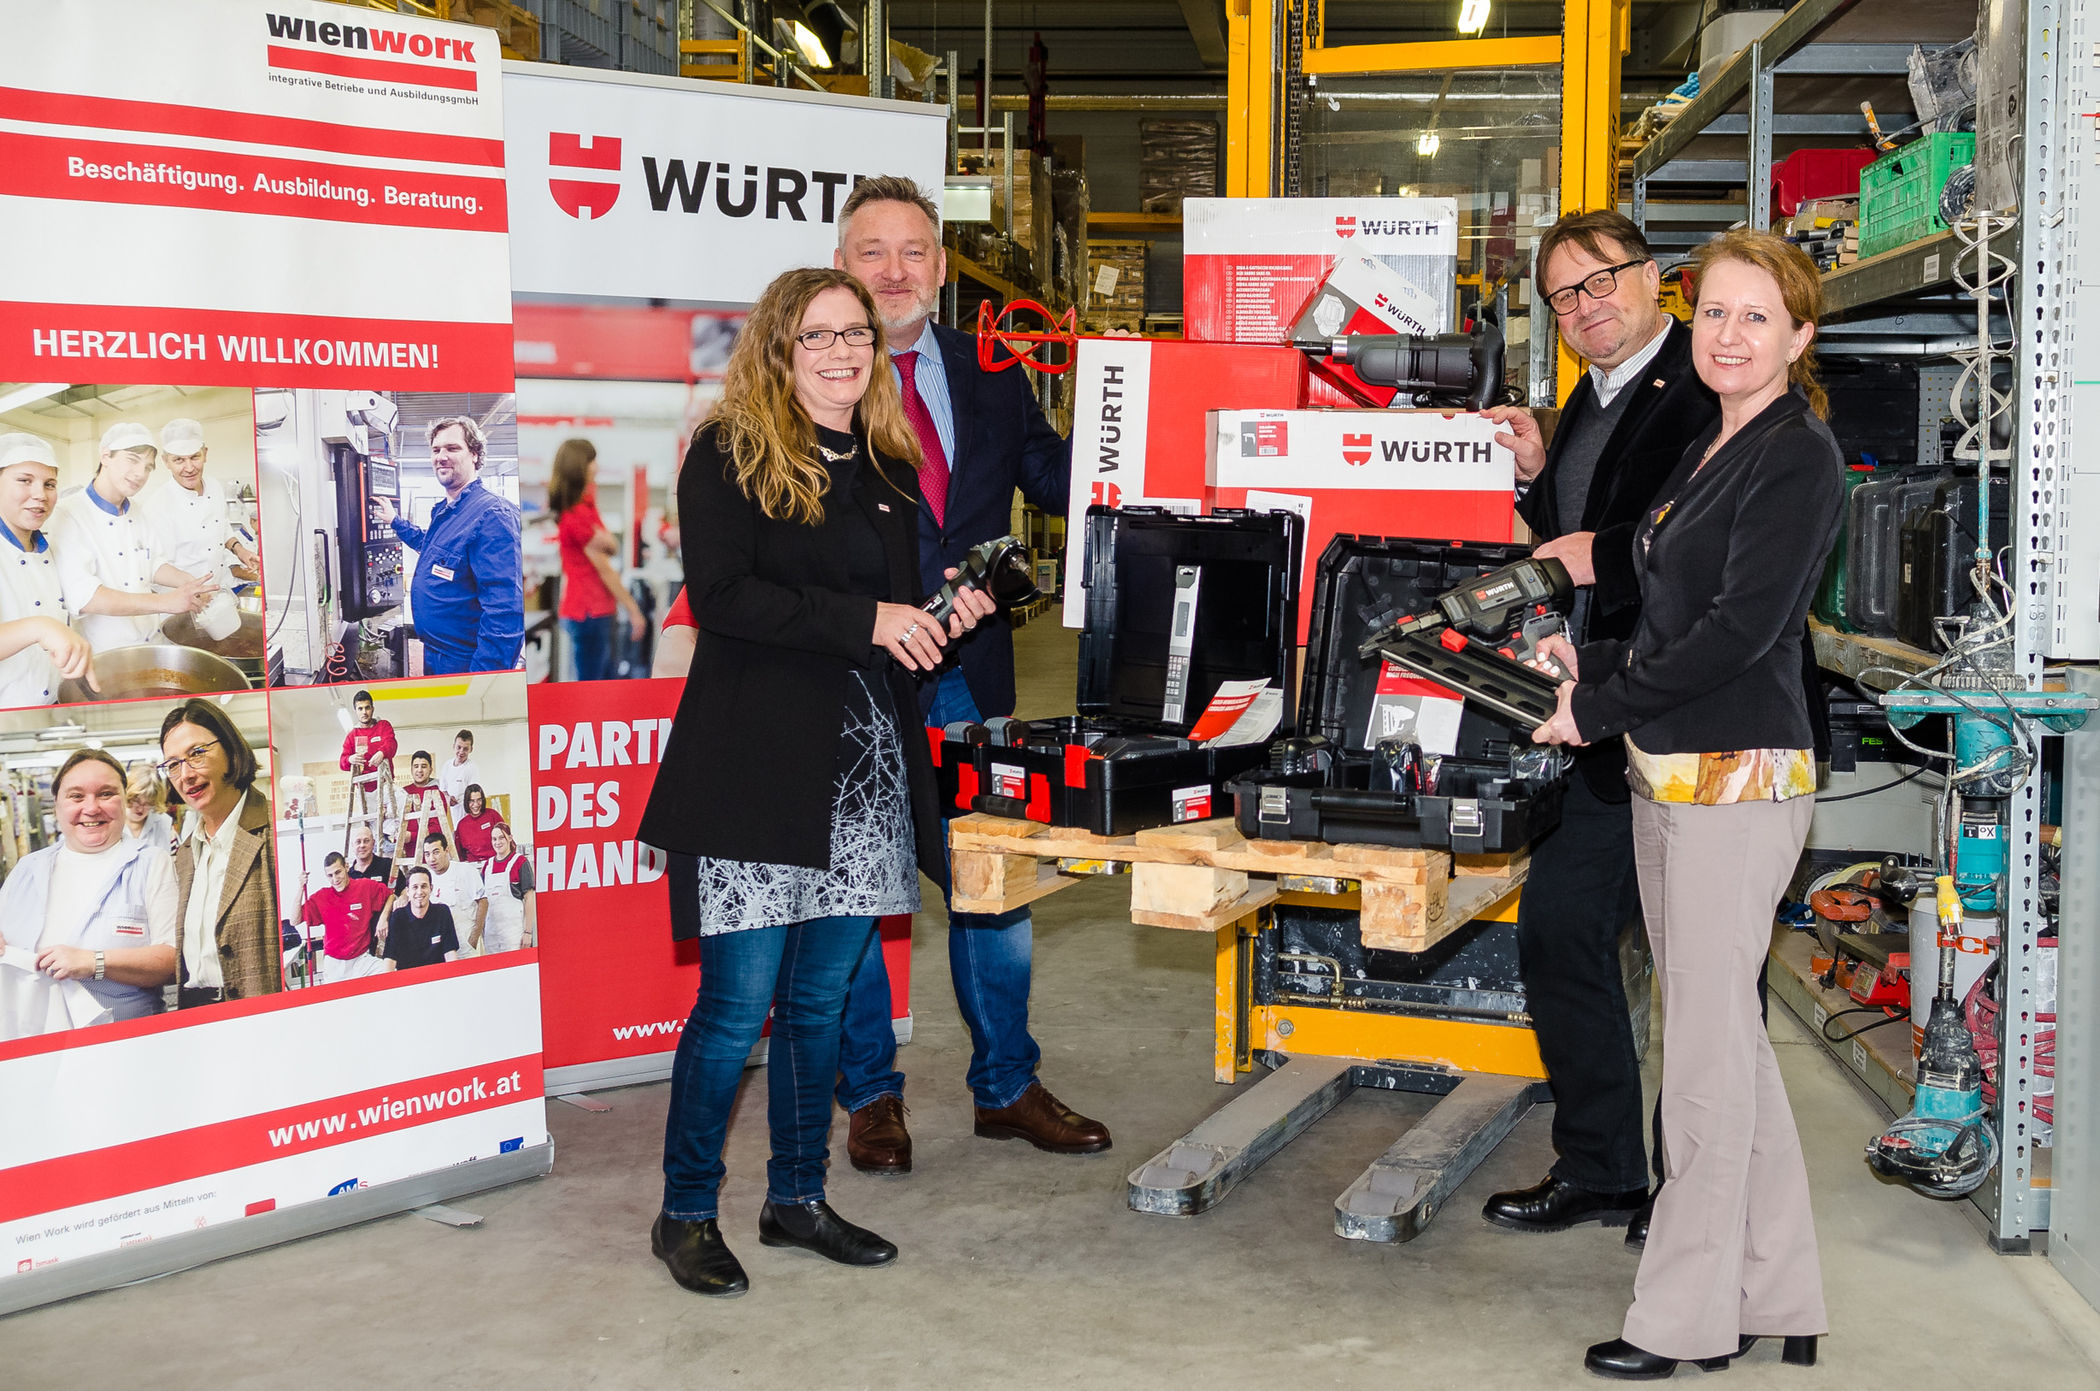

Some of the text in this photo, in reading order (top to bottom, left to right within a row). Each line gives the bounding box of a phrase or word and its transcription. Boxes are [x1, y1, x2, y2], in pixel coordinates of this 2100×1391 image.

[266, 13, 476, 63] wienwork
[268, 72, 479, 106] integrative Betriebe und AusbildungsgmbH
[68, 156, 484, 215] Beschäftigung. Ausbildung. Beratung.
[641, 156, 867, 223] WÜRT
[1361, 220, 1439, 235] WÜRTH
[1387, 303, 1427, 335] WÜRTH
[33, 328, 438, 369] HERZLICH WILLKOMMEN!
[1099, 366, 1124, 473] WÜRTH
[1381, 441, 1491, 463] WÜRTH
[537, 780, 620, 832] DES
[535, 839, 668, 893] HAND
[612, 1018, 689, 1041] www.
[268, 1070, 521, 1147] www.wienwork.at
[15, 1190, 217, 1245] Wien Work wird gefördert aus Mitteln von:
